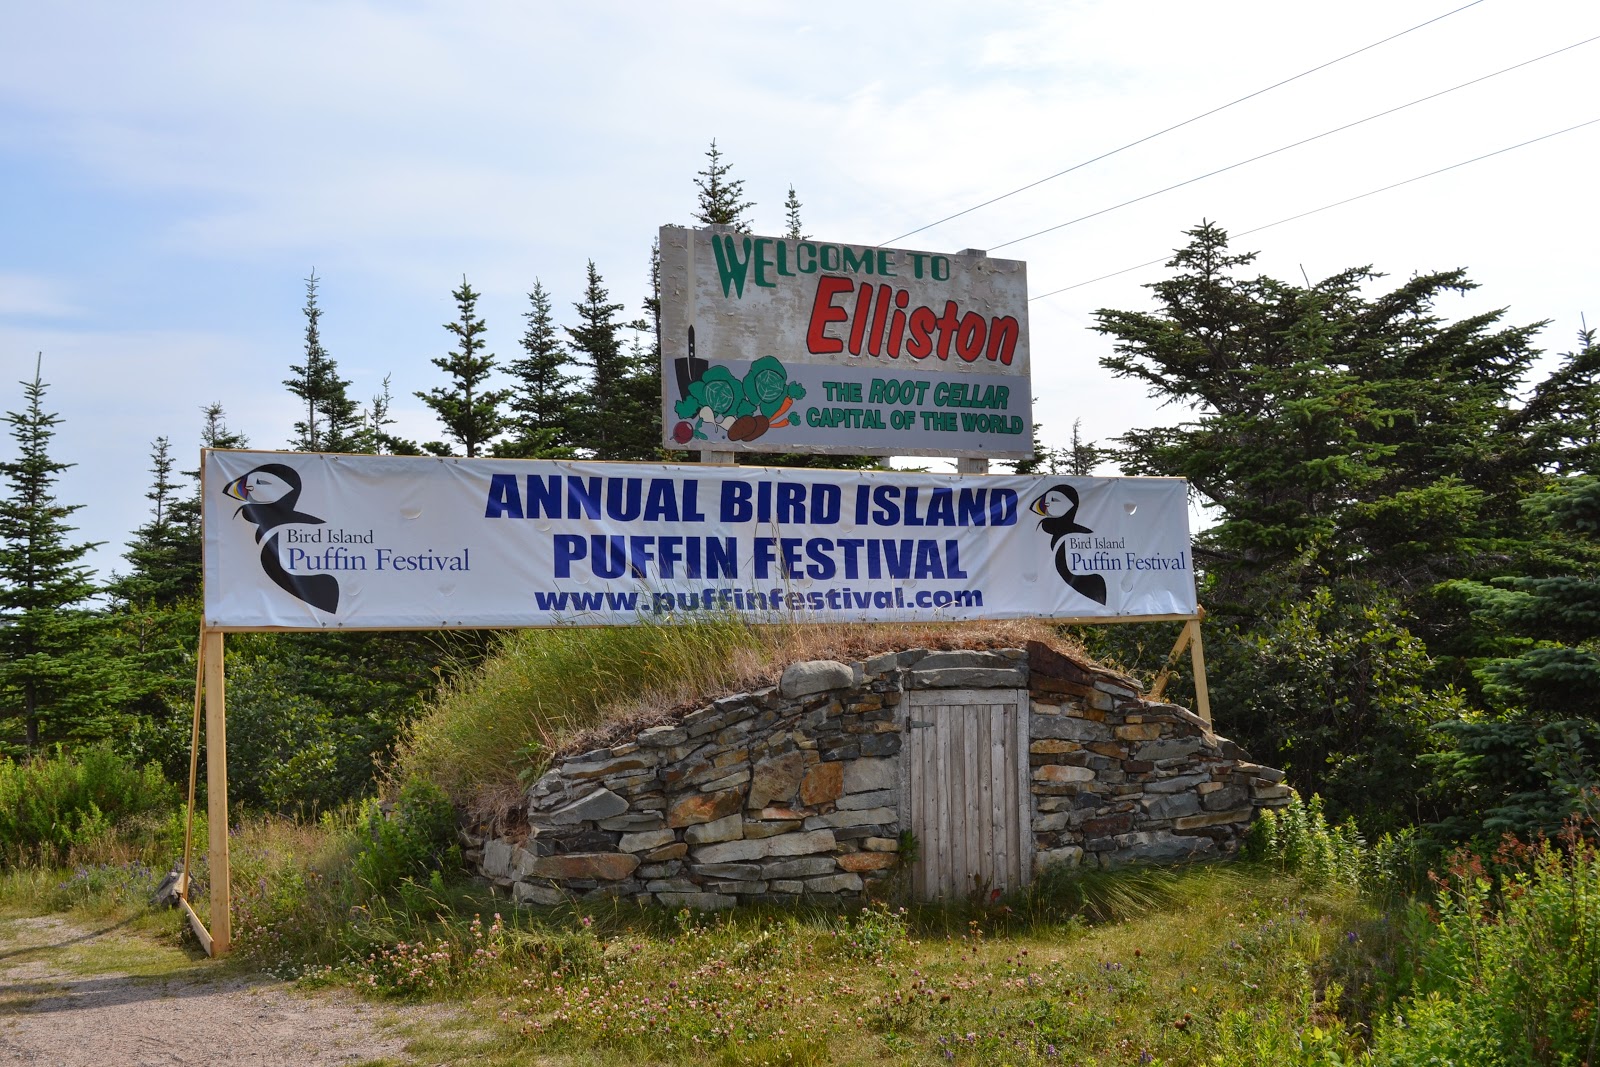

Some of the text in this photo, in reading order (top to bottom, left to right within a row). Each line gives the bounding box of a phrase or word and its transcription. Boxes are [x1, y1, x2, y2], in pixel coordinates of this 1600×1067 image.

[711, 233, 950, 299] WELCOME TO
[806, 275, 1019, 366] Elliston
[822, 378, 1010, 410] THE ROOT CELLAR
[806, 407, 1024, 434] CAPITAL OF THE WORLD
[485, 474, 1018, 527] ANNUAL BIRD ISLAND
[287, 528, 374, 544] Bird Island
[1070, 537, 1125, 549] Bird Island
[287, 547, 470, 572] Puffin Festival
[553, 534, 968, 580] PUFFIN FESTIVAL
[1071, 551, 1187, 570] Puffin Festival
[534, 588, 983, 615] www.puffinfestival.com
